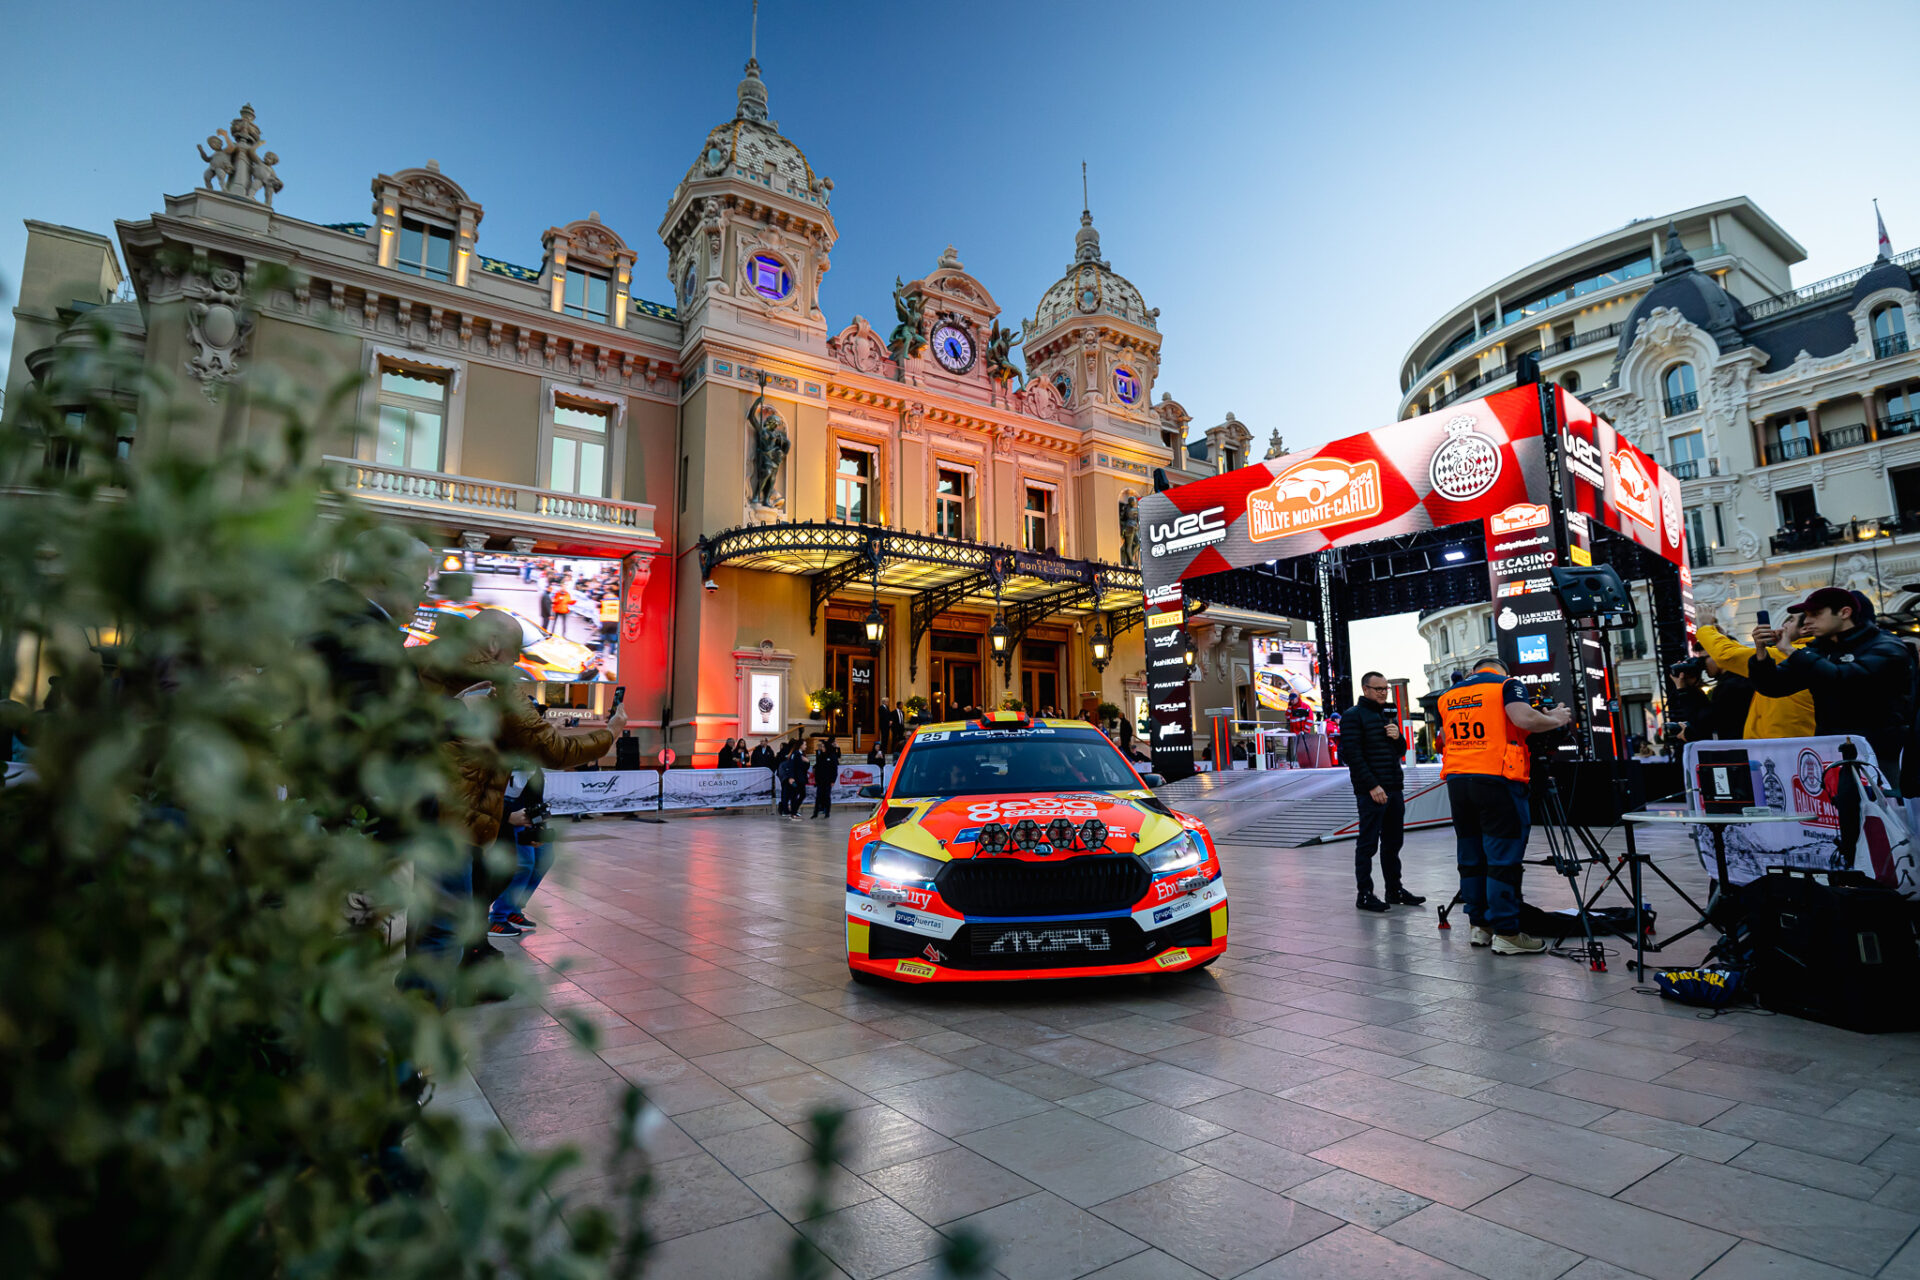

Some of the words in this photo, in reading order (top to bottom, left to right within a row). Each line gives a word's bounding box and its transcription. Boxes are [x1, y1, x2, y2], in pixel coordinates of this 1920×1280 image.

[1562, 426, 1603, 474] WRC
[1348, 468, 1374, 491] 2024
[1252, 498, 1275, 511] 2024
[1252, 508, 1290, 535] RALLYE
[1292, 478, 1376, 527] MONTE-CARLO
[1149, 505, 1226, 543] WRC
[1036, 559, 1066, 569] CASINO
[1492, 560, 1505, 571] LE
[1506, 552, 1555, 568] CASINO
[1146, 582, 1182, 599] WRC
[1497, 585, 1523, 598] GR
[1522, 615, 1563, 625] OFFICIELLE
[1519, 649, 1548, 662] bleu
[1154, 680, 1185, 689] FANATEC
[1447, 694, 1483, 706] WRC
[1459, 712, 1470, 720] TV
[1450, 721, 1486, 740] 130
[921, 733, 942, 742] 25
[708, 779, 738, 787] CASINO
[1796, 787, 1823, 816] RALLYE
[967, 797, 1098, 822] gesa
[1009, 809, 1094, 817] SPORTS
[1159, 950, 1188, 965] PIRELLI
[899, 962, 933, 976] PIRELLI
